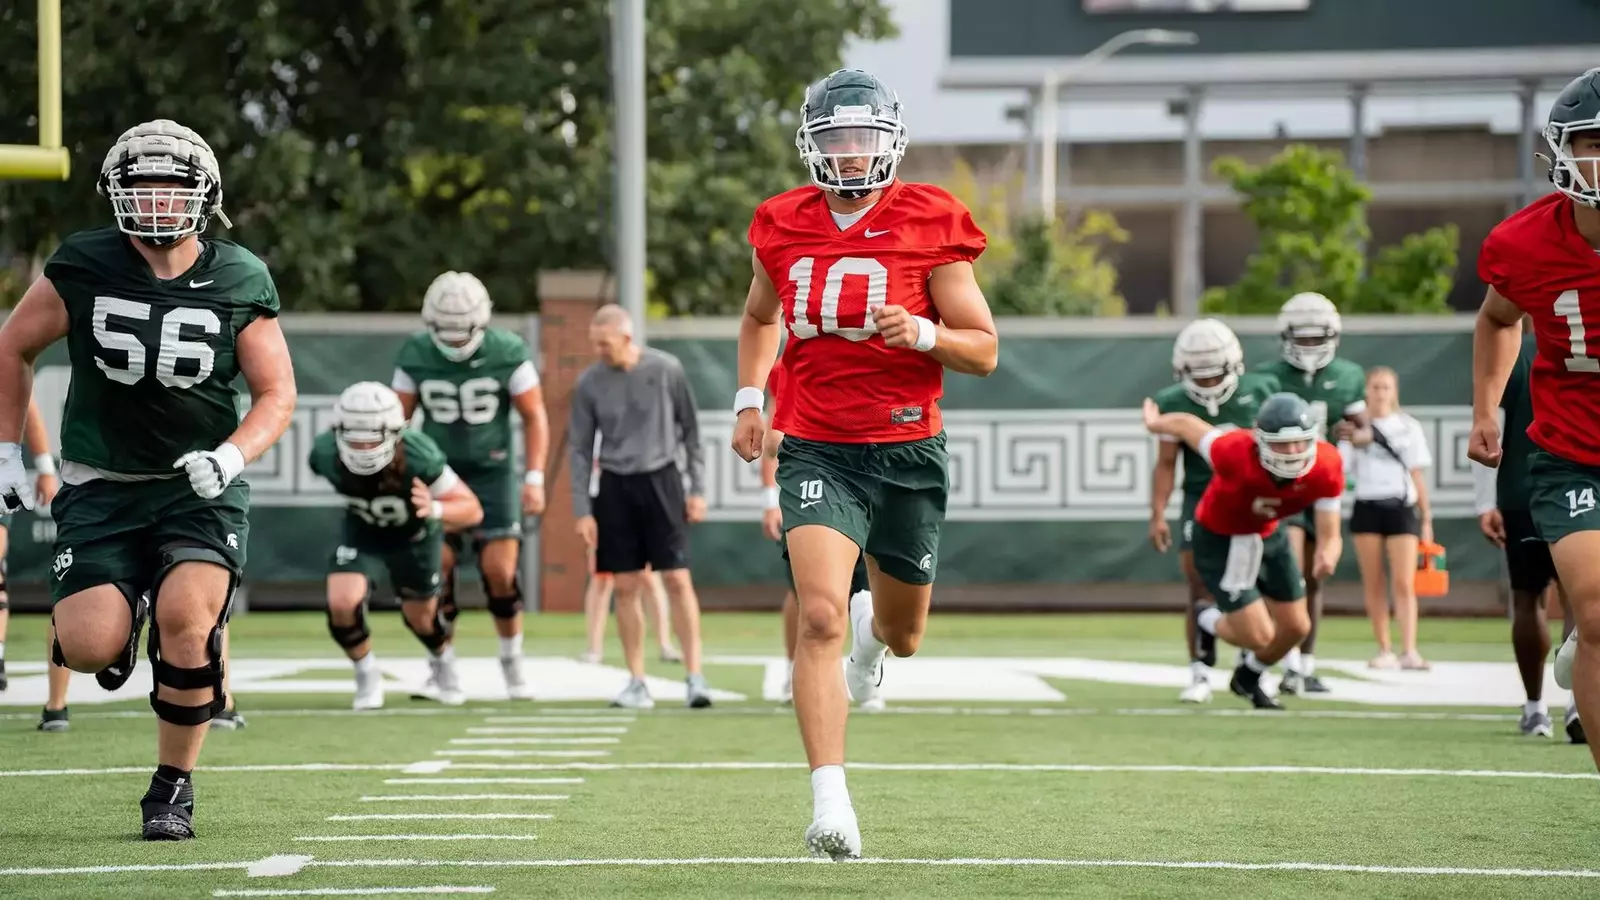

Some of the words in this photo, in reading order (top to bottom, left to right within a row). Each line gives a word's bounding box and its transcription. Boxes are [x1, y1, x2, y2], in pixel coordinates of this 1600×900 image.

[788, 257, 888, 342] 10
[92, 296, 221, 389] 56
[419, 376, 501, 425] 66
[799, 479, 823, 500] 10
[1565, 487, 1597, 510] 14
